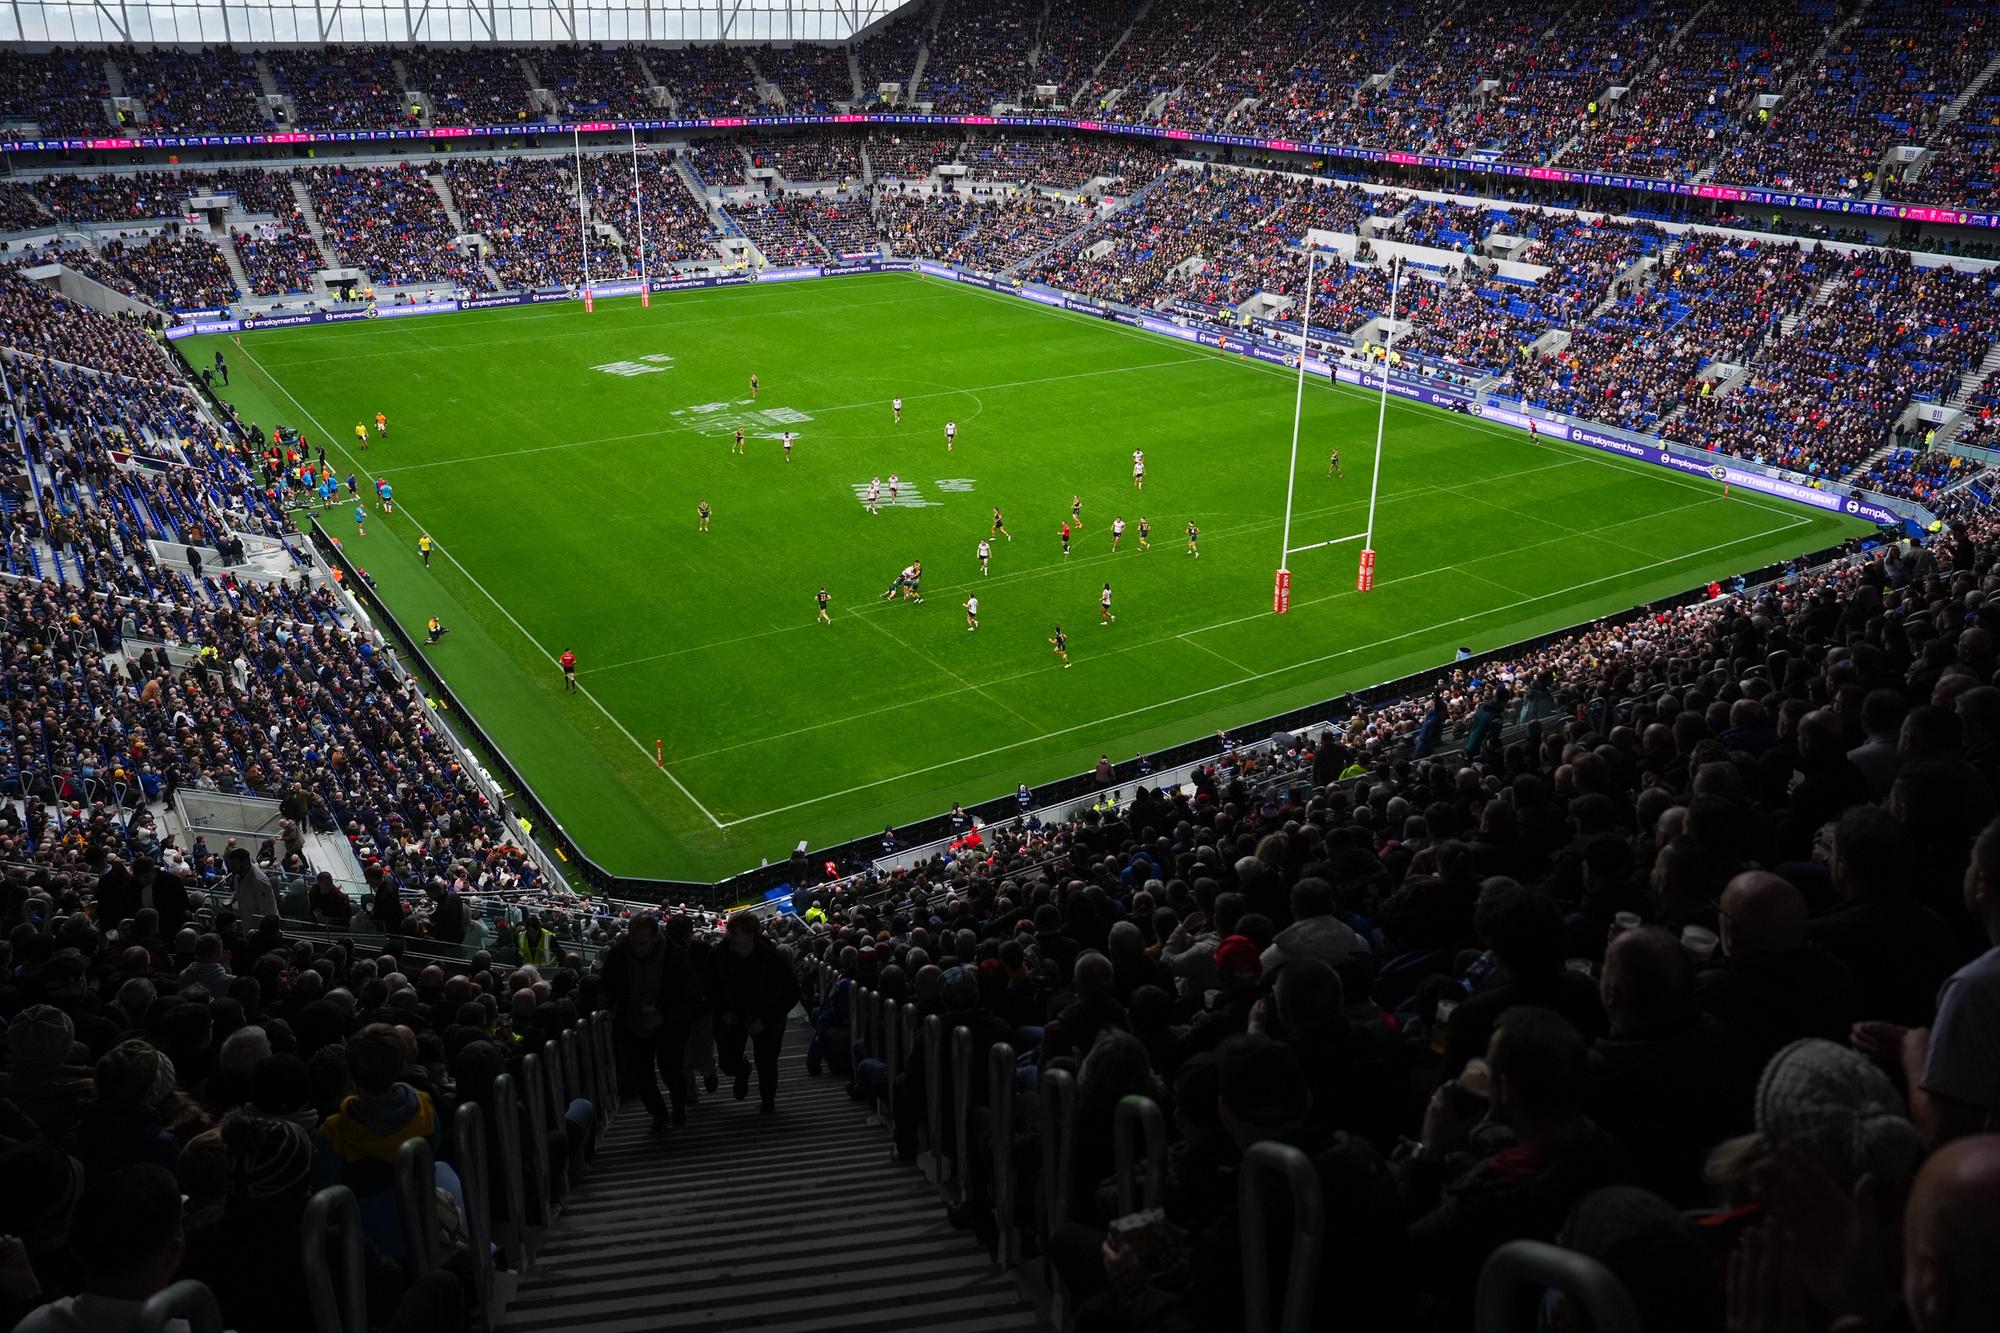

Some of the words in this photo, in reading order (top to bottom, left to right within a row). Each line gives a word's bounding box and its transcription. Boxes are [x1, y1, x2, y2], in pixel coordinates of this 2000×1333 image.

[1905, 150, 1916, 158] 220
[1932, 409, 1943, 419] 011
[1583, 434, 1627, 451] employment
[1627, 444, 1644, 455] hero
[1726, 472, 1774, 490] VERYTHING
[1776, 484, 1836, 506] EMPLOYMENT
